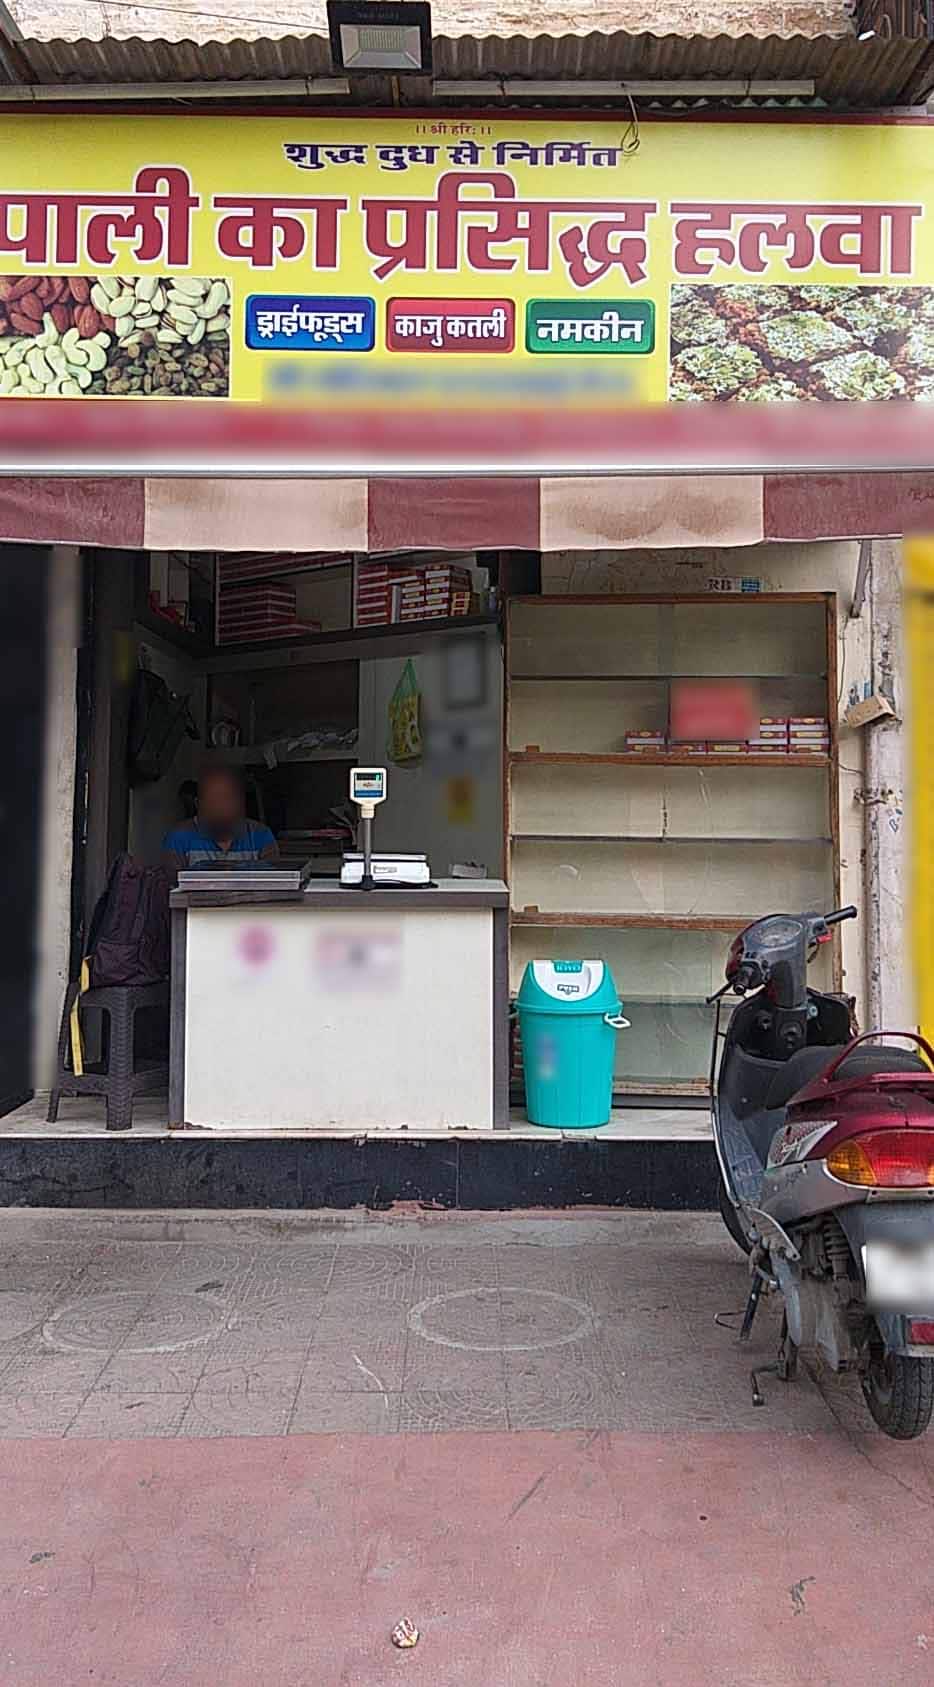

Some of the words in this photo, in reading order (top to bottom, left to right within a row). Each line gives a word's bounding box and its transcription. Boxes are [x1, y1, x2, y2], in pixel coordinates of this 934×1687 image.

[284, 143, 368, 169] शुद्ध
[375, 145, 440, 170] दुध
[446, 140, 485, 165] से
[492, 141, 624, 166] निर्मित
[0, 166, 199, 265] पाली
[213, 196, 347, 268] का
[361, 171, 656, 287] प्रसिद्ध
[670, 203, 922, 275] हलवा
[394, 315, 443, 347] काजु
[446, 309, 506, 338] कतली
[536, 311, 645, 343] नमकीन
